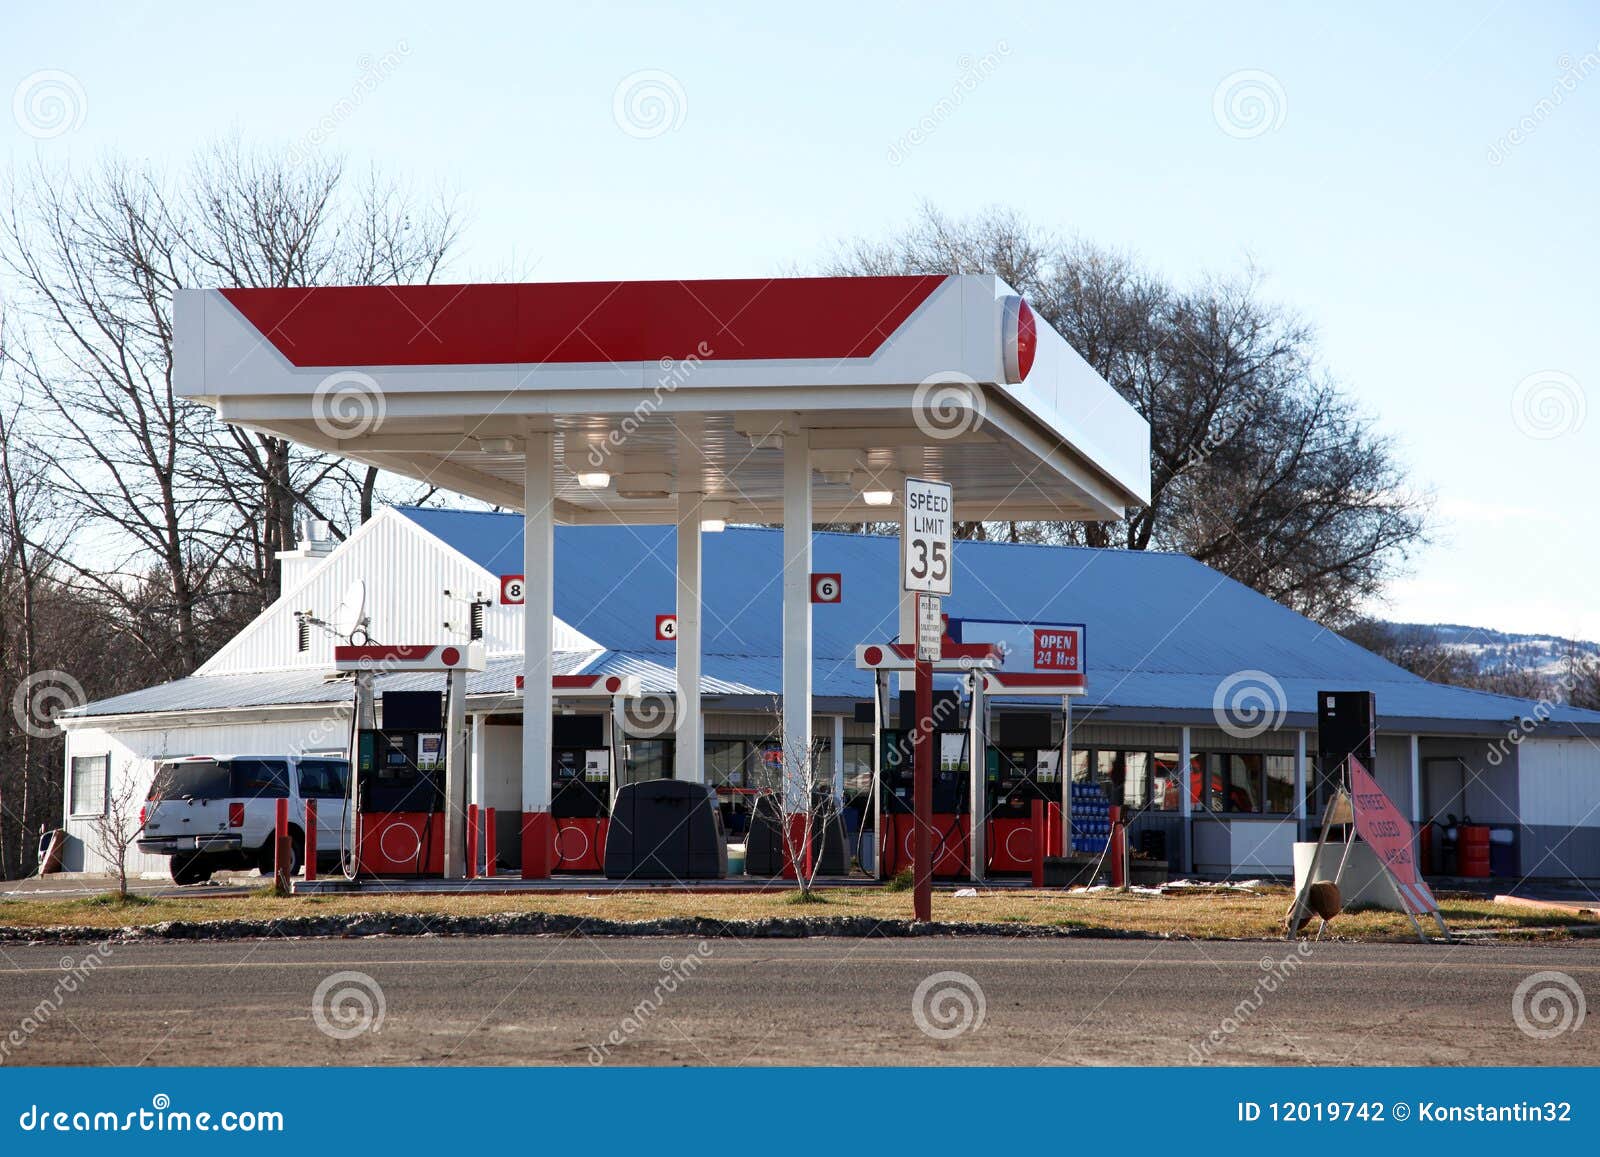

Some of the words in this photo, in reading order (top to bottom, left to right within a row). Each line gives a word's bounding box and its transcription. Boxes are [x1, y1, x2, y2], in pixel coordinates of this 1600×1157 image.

[910, 492, 948, 513] SPEED
[914, 517, 944, 536] LIMIT
[910, 539, 947, 581] 35
[510, 584, 521, 597] 8
[822, 583, 833, 595] 6
[664, 623, 674, 634] 4
[1040, 635, 1072, 649] OPEN
[1036, 650, 1052, 665] 24
[1056, 651, 1076, 666] Hrs
[1356, 794, 1387, 810] STREET
[1368, 821, 1401, 838] CLOSED
